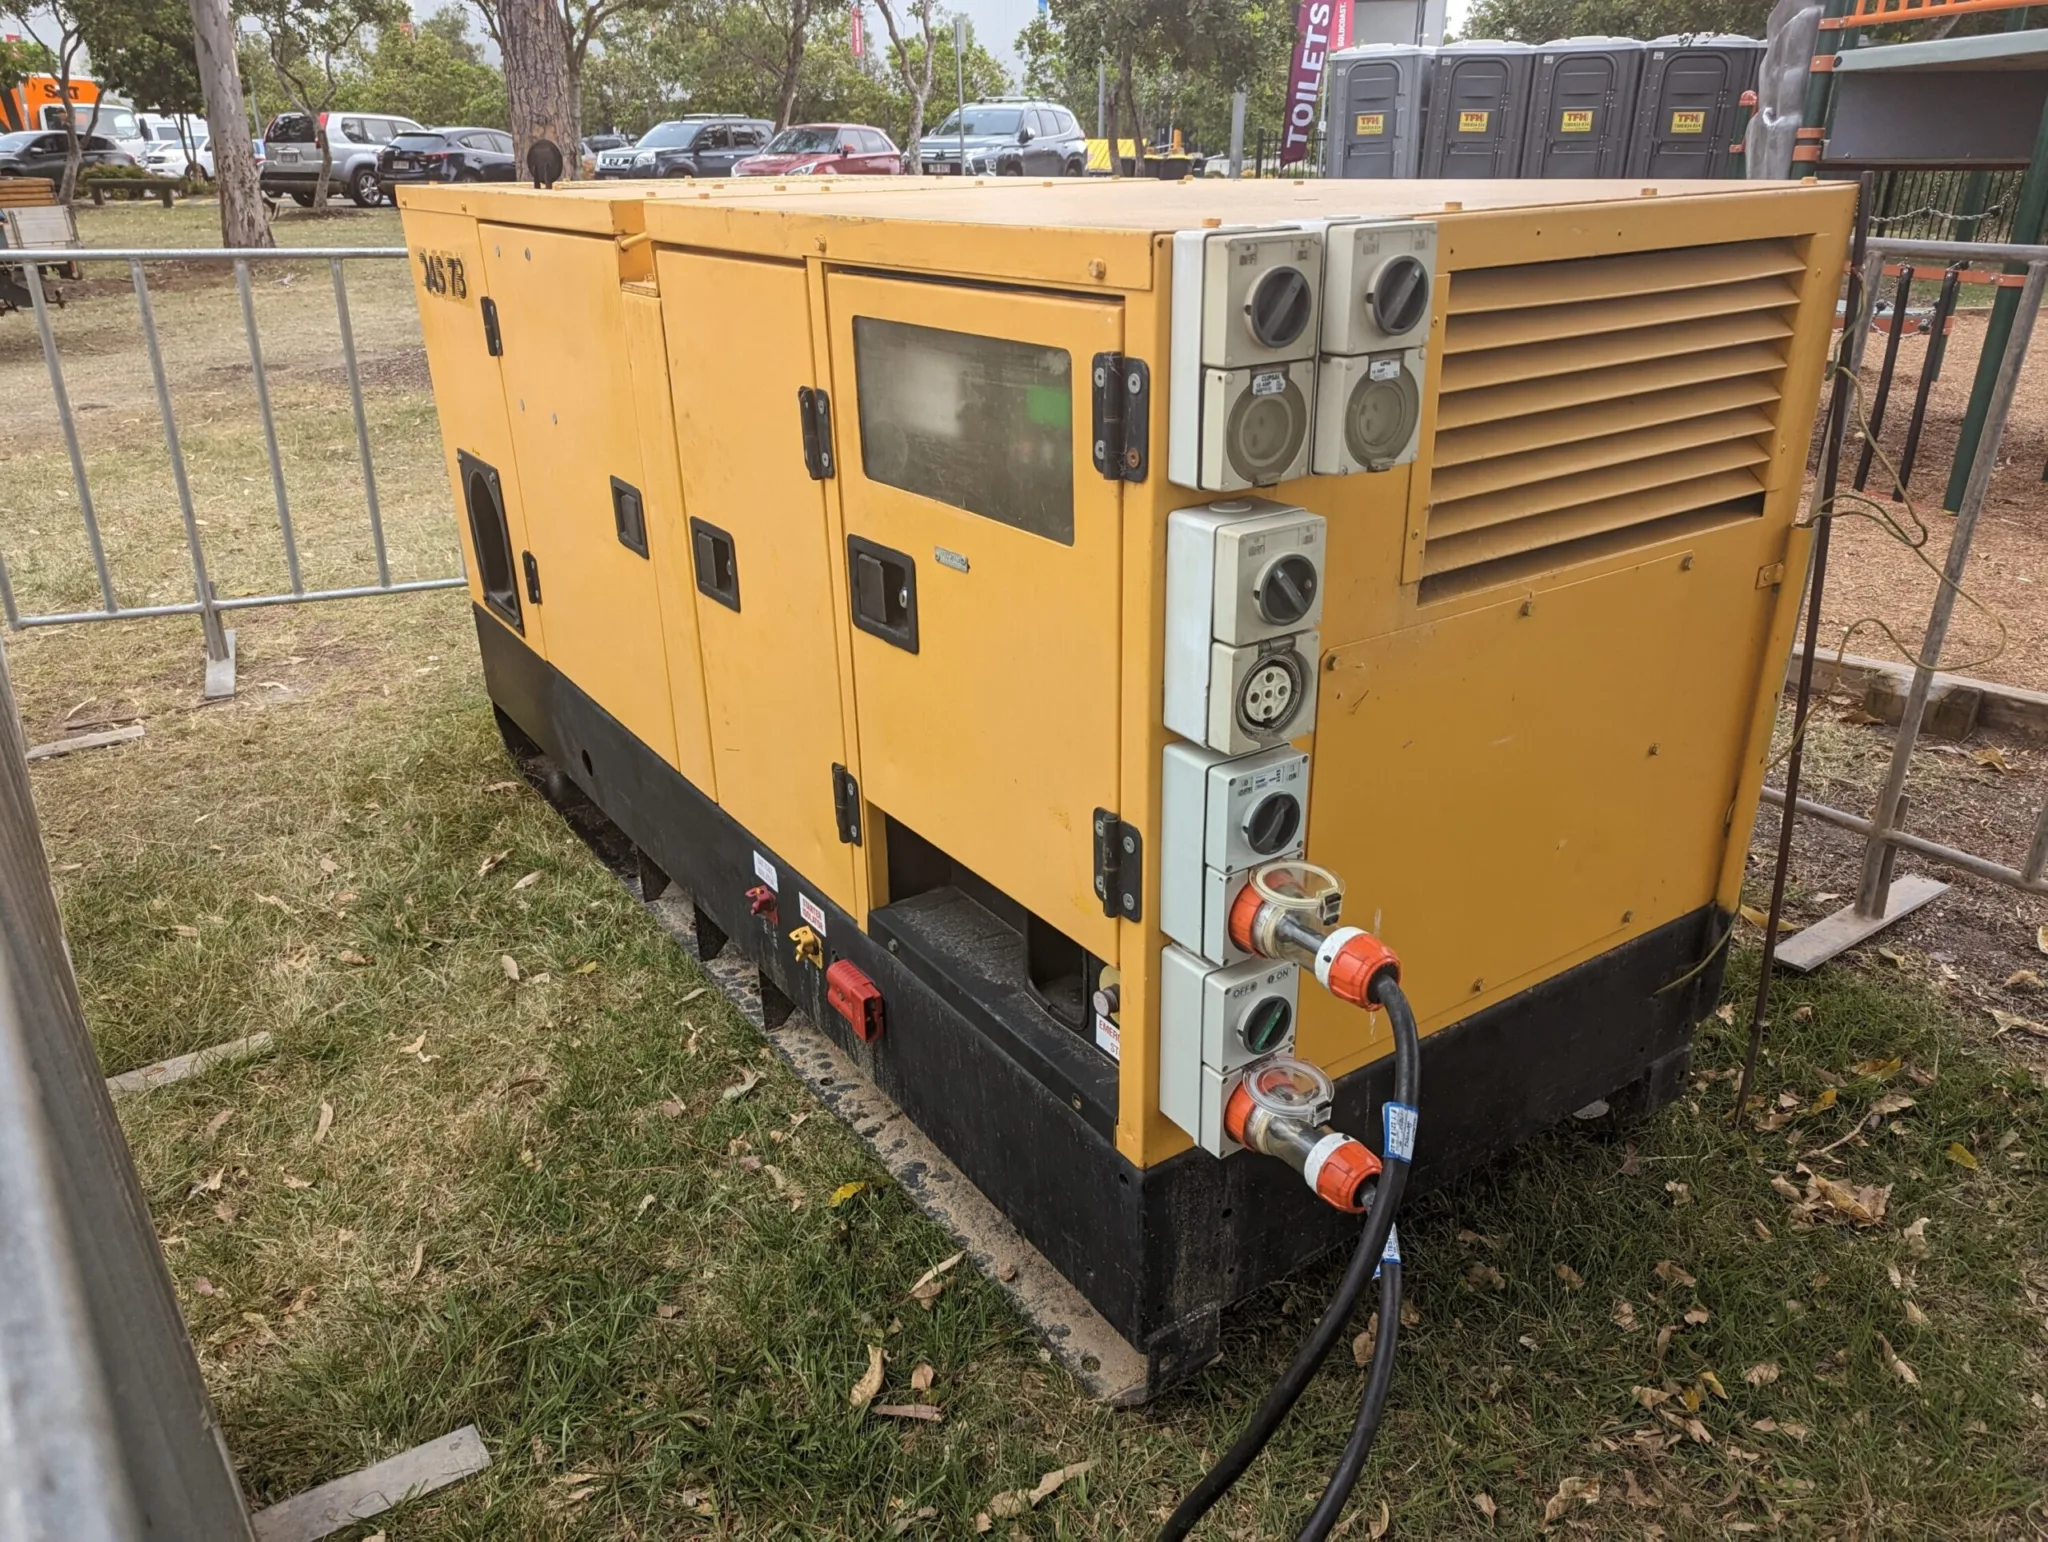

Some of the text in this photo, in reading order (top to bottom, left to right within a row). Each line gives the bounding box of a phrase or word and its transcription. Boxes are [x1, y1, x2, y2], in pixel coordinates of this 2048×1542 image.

[1286, 2, 1330, 148] TOILETS
[1276, 969, 1290, 981] ON
[1233, 984, 1250, 998] OFF
